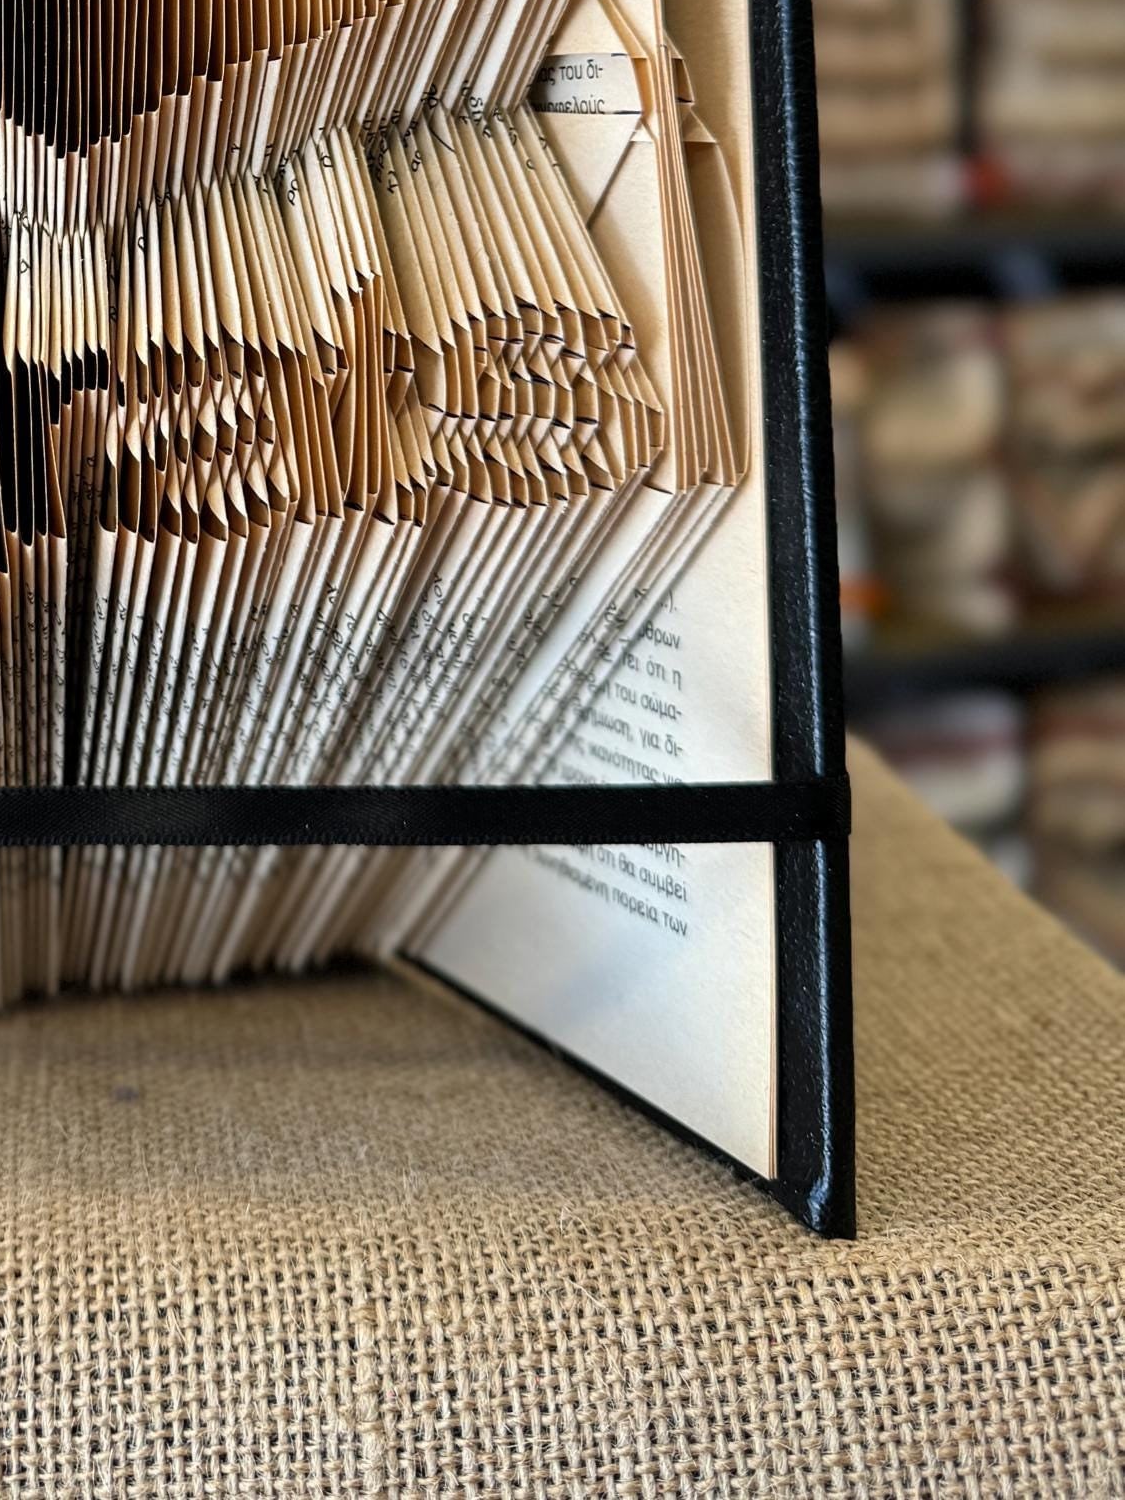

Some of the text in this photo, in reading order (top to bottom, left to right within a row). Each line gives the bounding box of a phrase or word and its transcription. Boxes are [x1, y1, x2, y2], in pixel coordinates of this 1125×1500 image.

[559, 64, 583, 81] του
[586, 59, 604, 80] δι-
[646, 655, 666, 681] ότι
[672, 669, 682, 691] η
[615, 683, 637, 705] του
[641, 691, 683, 722] σώμα-
[639, 728, 660, 749] για
[665, 734, 683, 757] δι-
[619, 852, 635, 876] θα
[639, 866, 687, 901] συμβεί
[612, 886, 659, 924] πορεία
[662, 910, 687, 937] των
